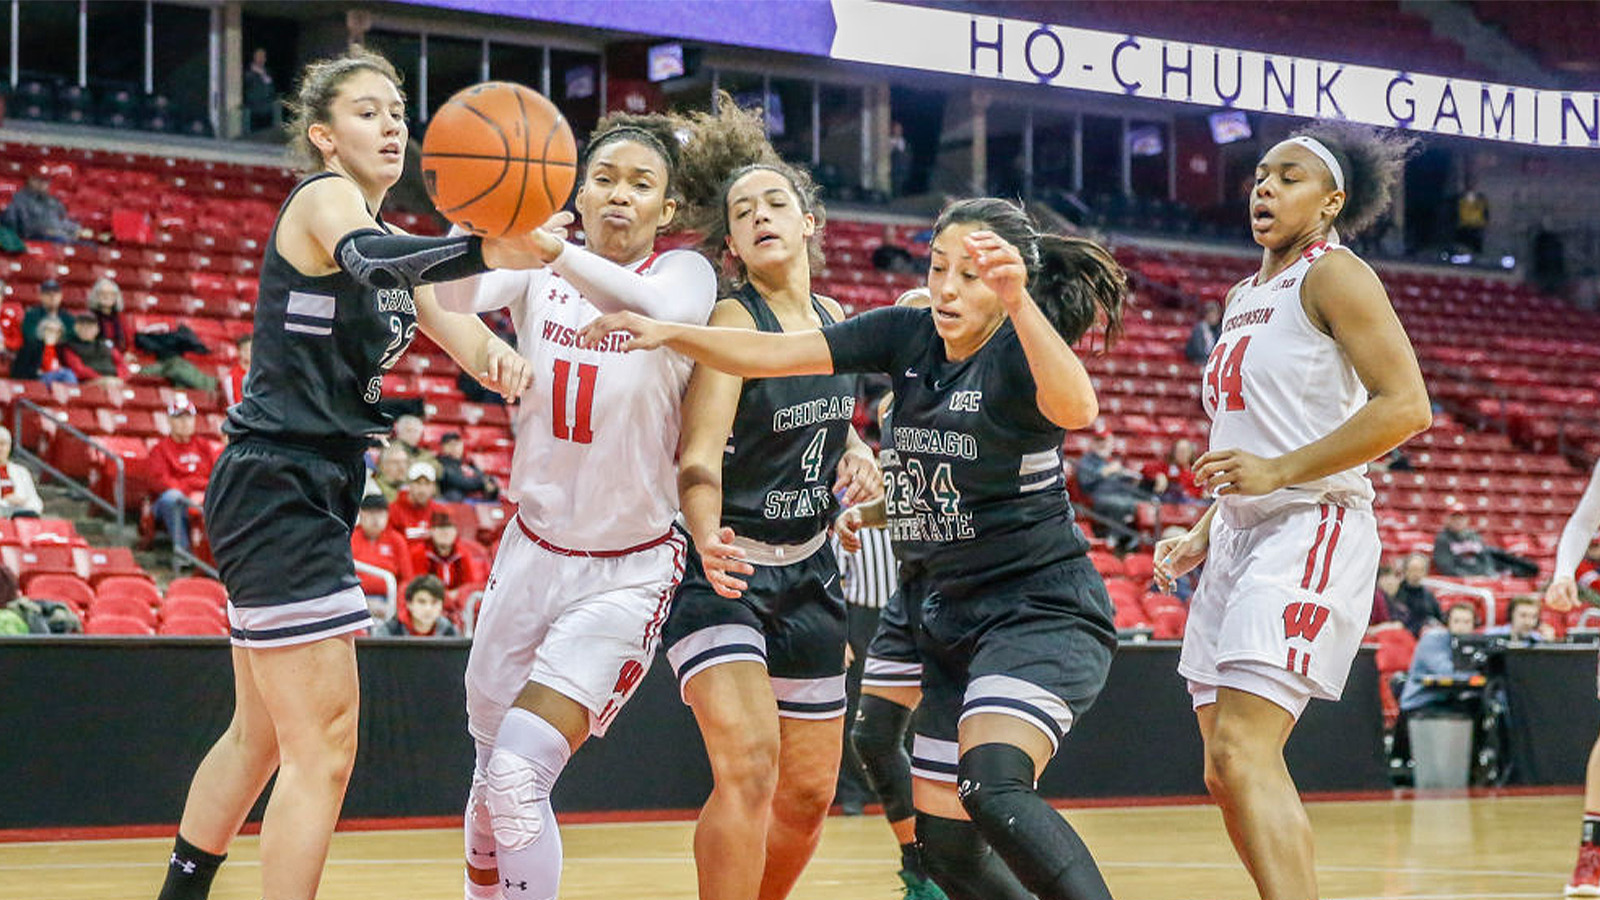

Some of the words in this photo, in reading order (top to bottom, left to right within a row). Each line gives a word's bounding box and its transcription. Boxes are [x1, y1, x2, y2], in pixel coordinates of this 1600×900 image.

[970, 19, 1344, 117] HO-CHUNK
[1386, 74, 1599, 142] GAMIN
[552, 358, 599, 445] 11
[1207, 335, 1252, 412] 34
[801, 427, 828, 483] 4
[907, 457, 961, 516] 24
[1283, 601, 1331, 633] W
